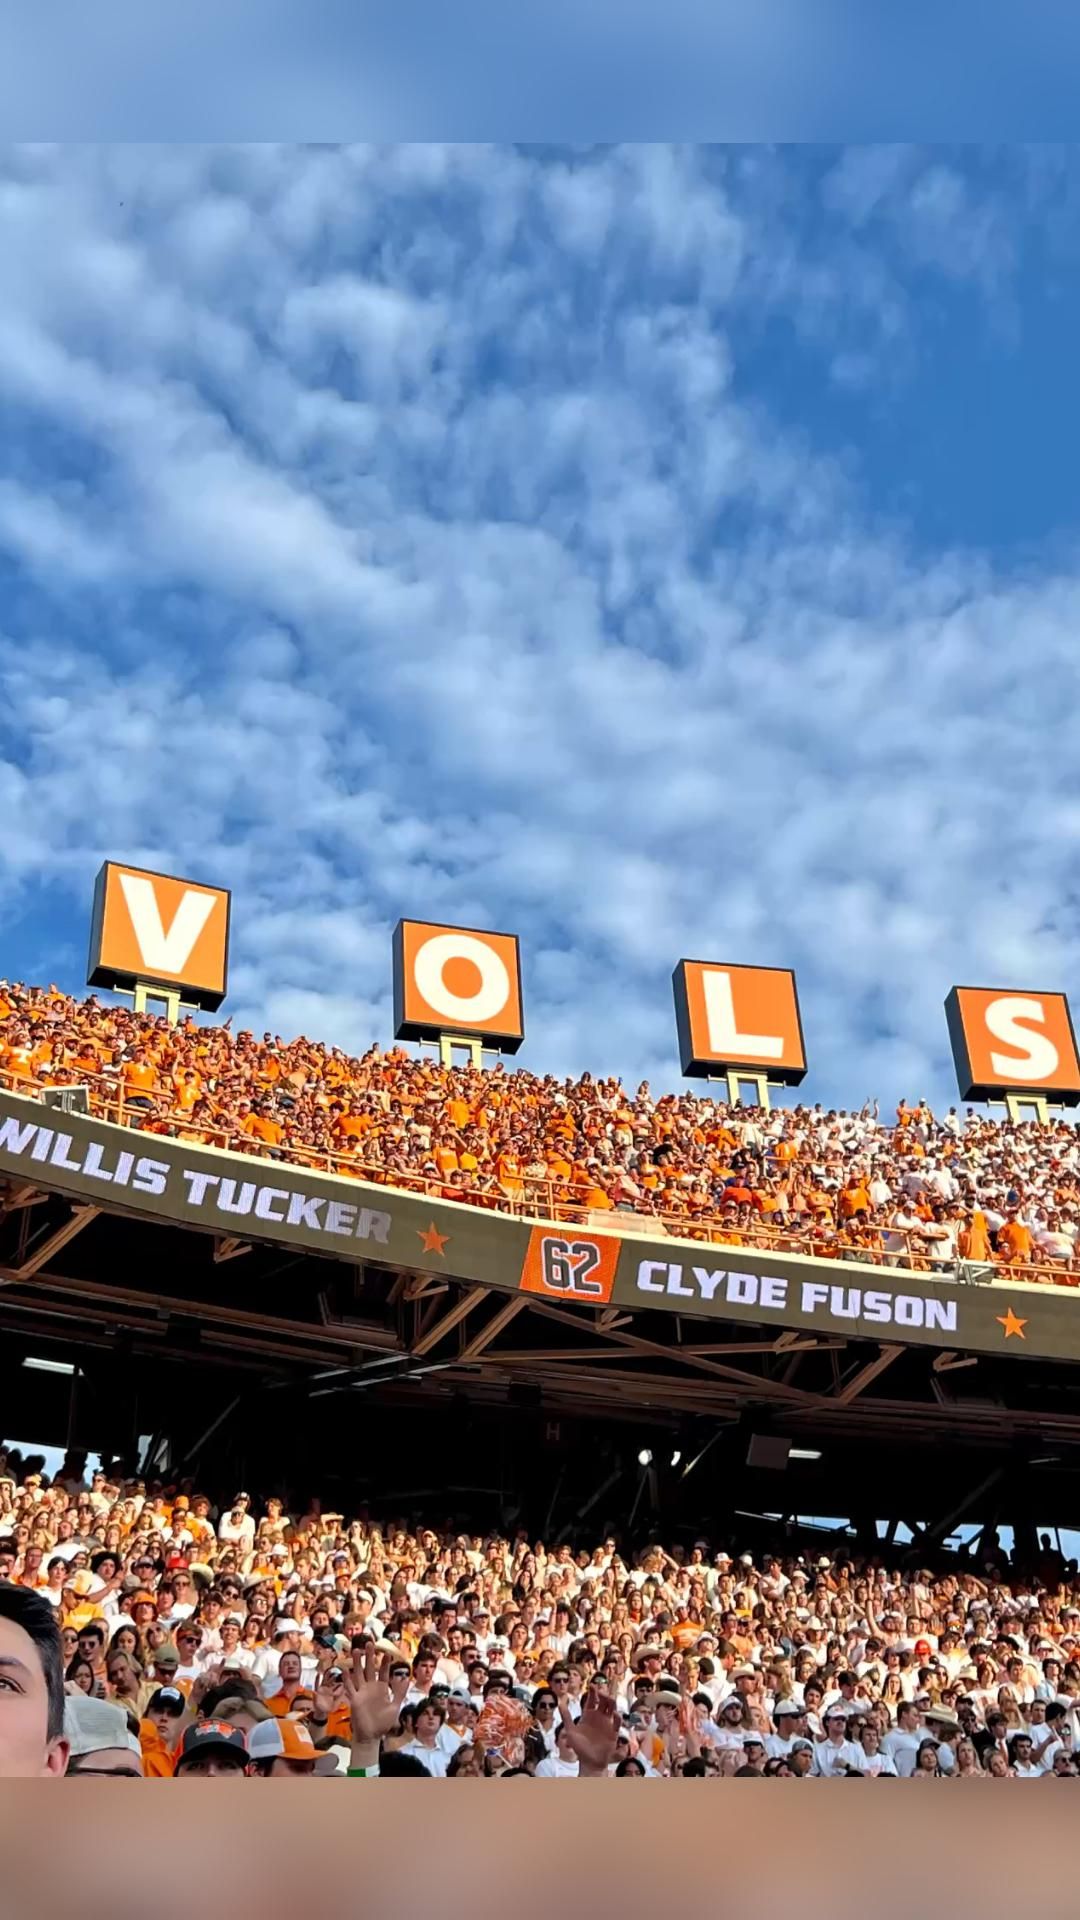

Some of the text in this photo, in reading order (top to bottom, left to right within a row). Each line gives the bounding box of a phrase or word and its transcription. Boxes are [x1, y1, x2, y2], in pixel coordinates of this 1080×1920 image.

[118, 873, 1059, 1081] V O L S
[183, 1169, 392, 1245] TUCKER
[541, 1236, 957, 1332] 62 CLYDE FUSON
